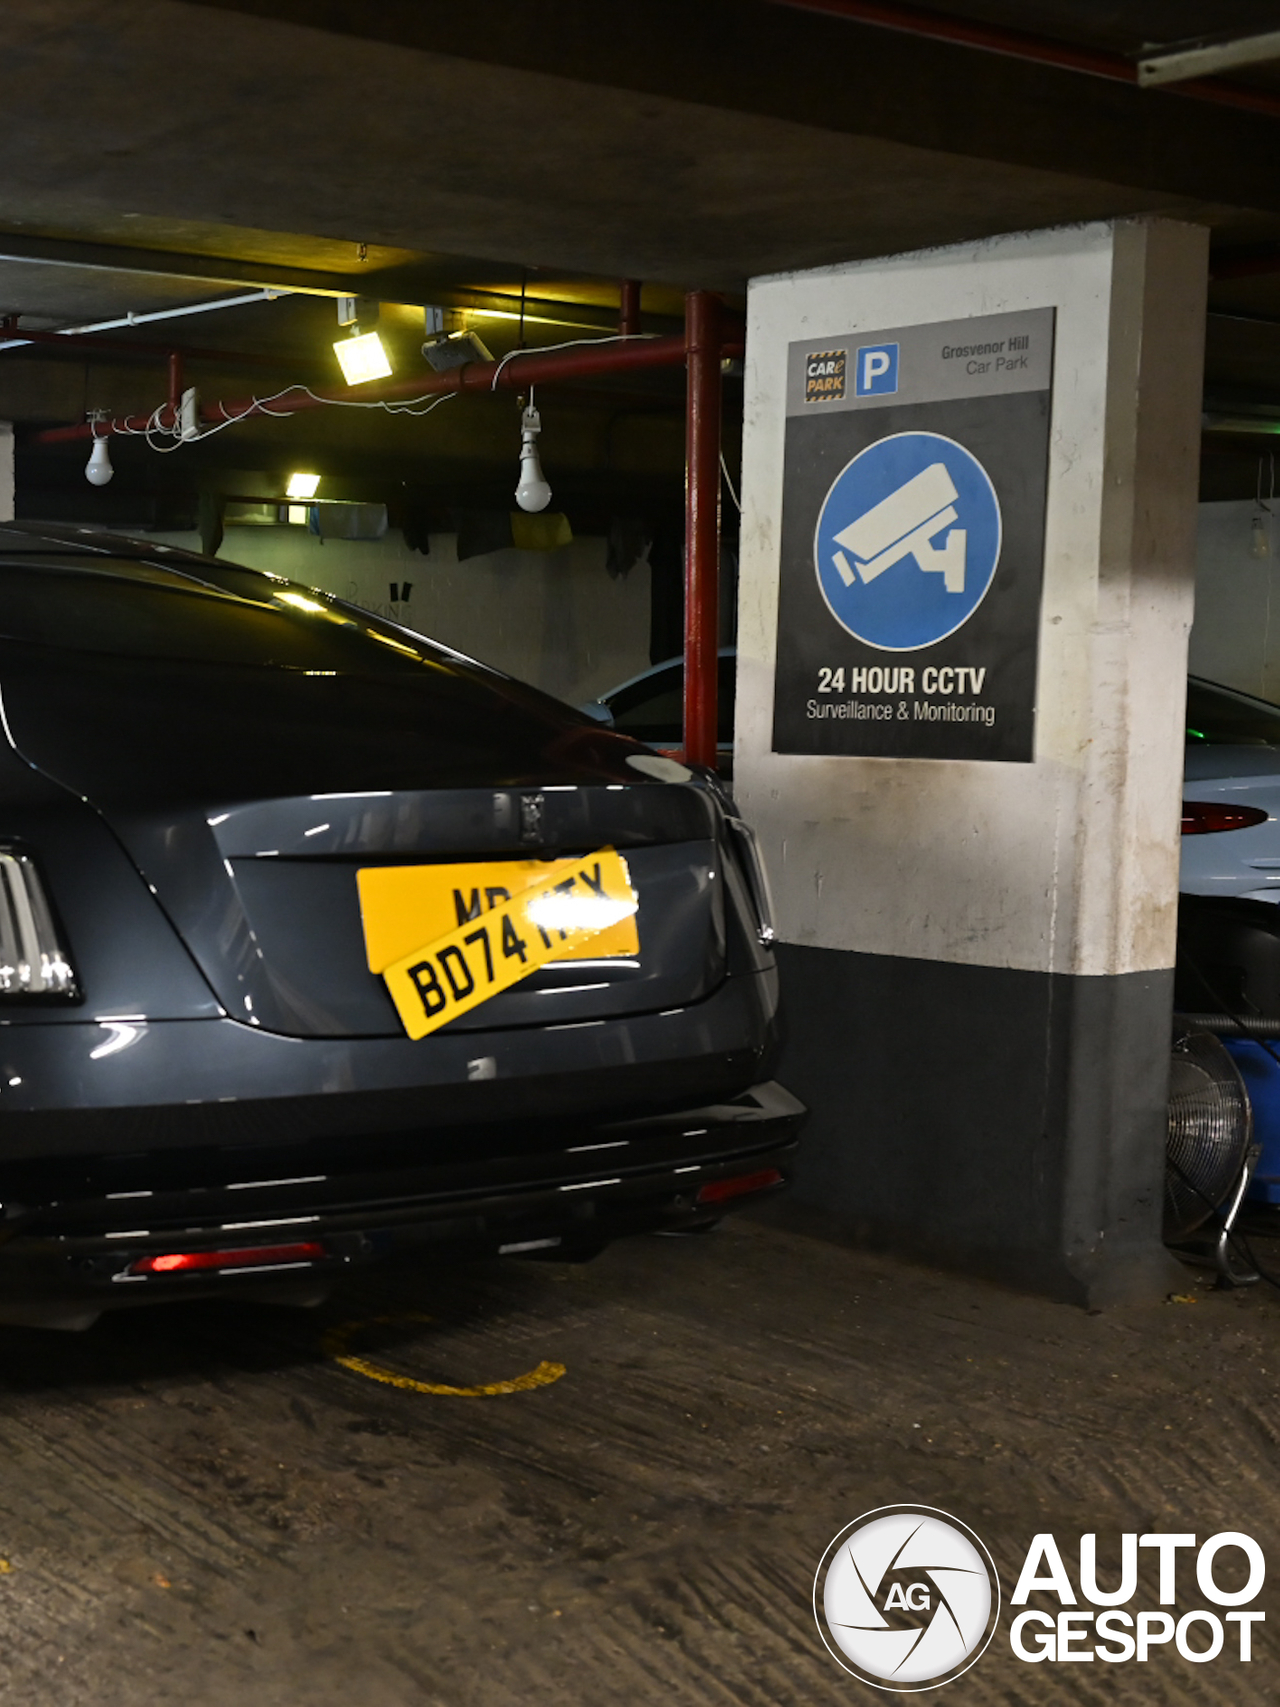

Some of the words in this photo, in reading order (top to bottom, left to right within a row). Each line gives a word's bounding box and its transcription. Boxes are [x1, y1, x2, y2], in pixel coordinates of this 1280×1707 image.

[941, 341, 1006, 359] Grosvenor
[1007, 335, 1029, 351] Hill
[863, 351, 890, 390] P
[966, 360, 992, 375] Car
[995, 355, 1028, 372] Park
[806, 375, 844, 393] PARK
[817, 667, 846, 693] 24
[851, 667, 916, 694] HOUR
[921, 667, 987, 695] CCTV
[806, 699, 893, 721] Surveillance
[896, 702, 910, 720] &
[913, 701, 996, 727] Monitoring
[406, 913, 528, 1019] BD74
